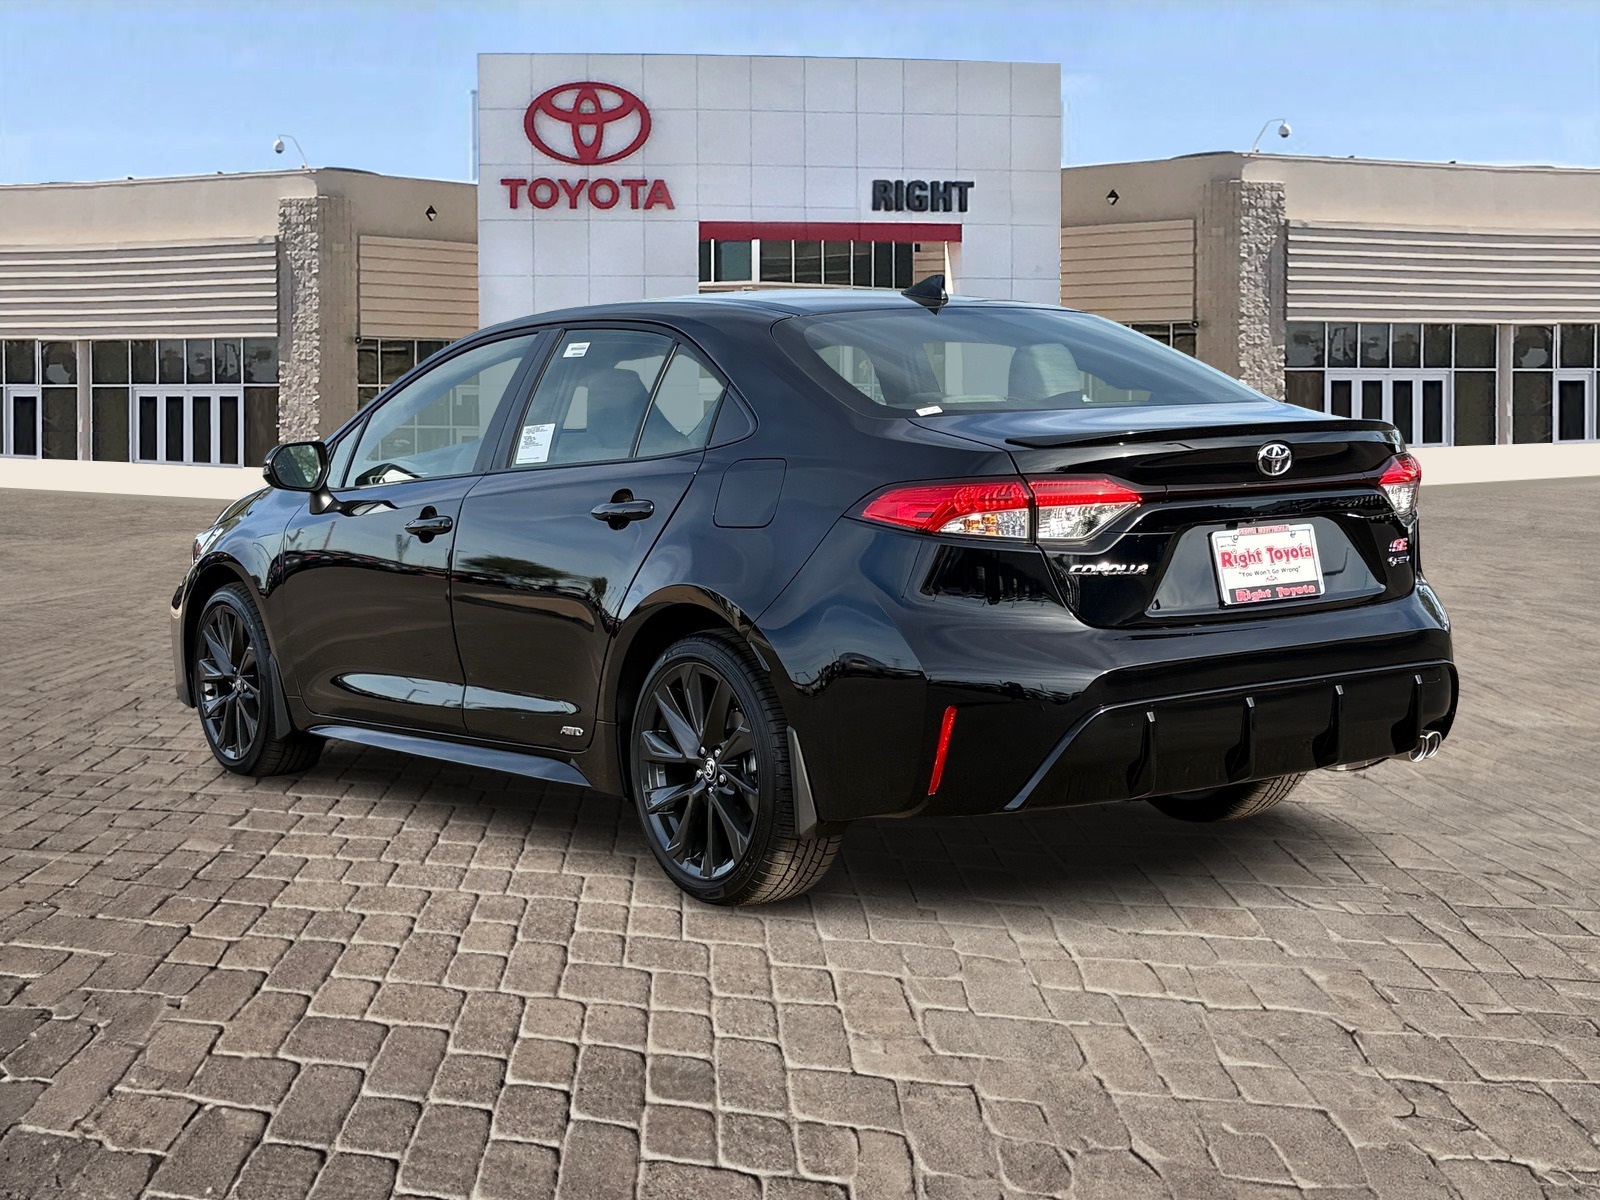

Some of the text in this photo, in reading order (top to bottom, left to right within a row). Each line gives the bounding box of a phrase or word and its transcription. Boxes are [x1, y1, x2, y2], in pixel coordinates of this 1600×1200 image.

[500, 178, 675, 209] TOYOTA
[872, 180, 974, 212] RIGHT
[1220, 543, 1313, 569] Right Toyota
[1236, 584, 1316, 602] Right Toyota
